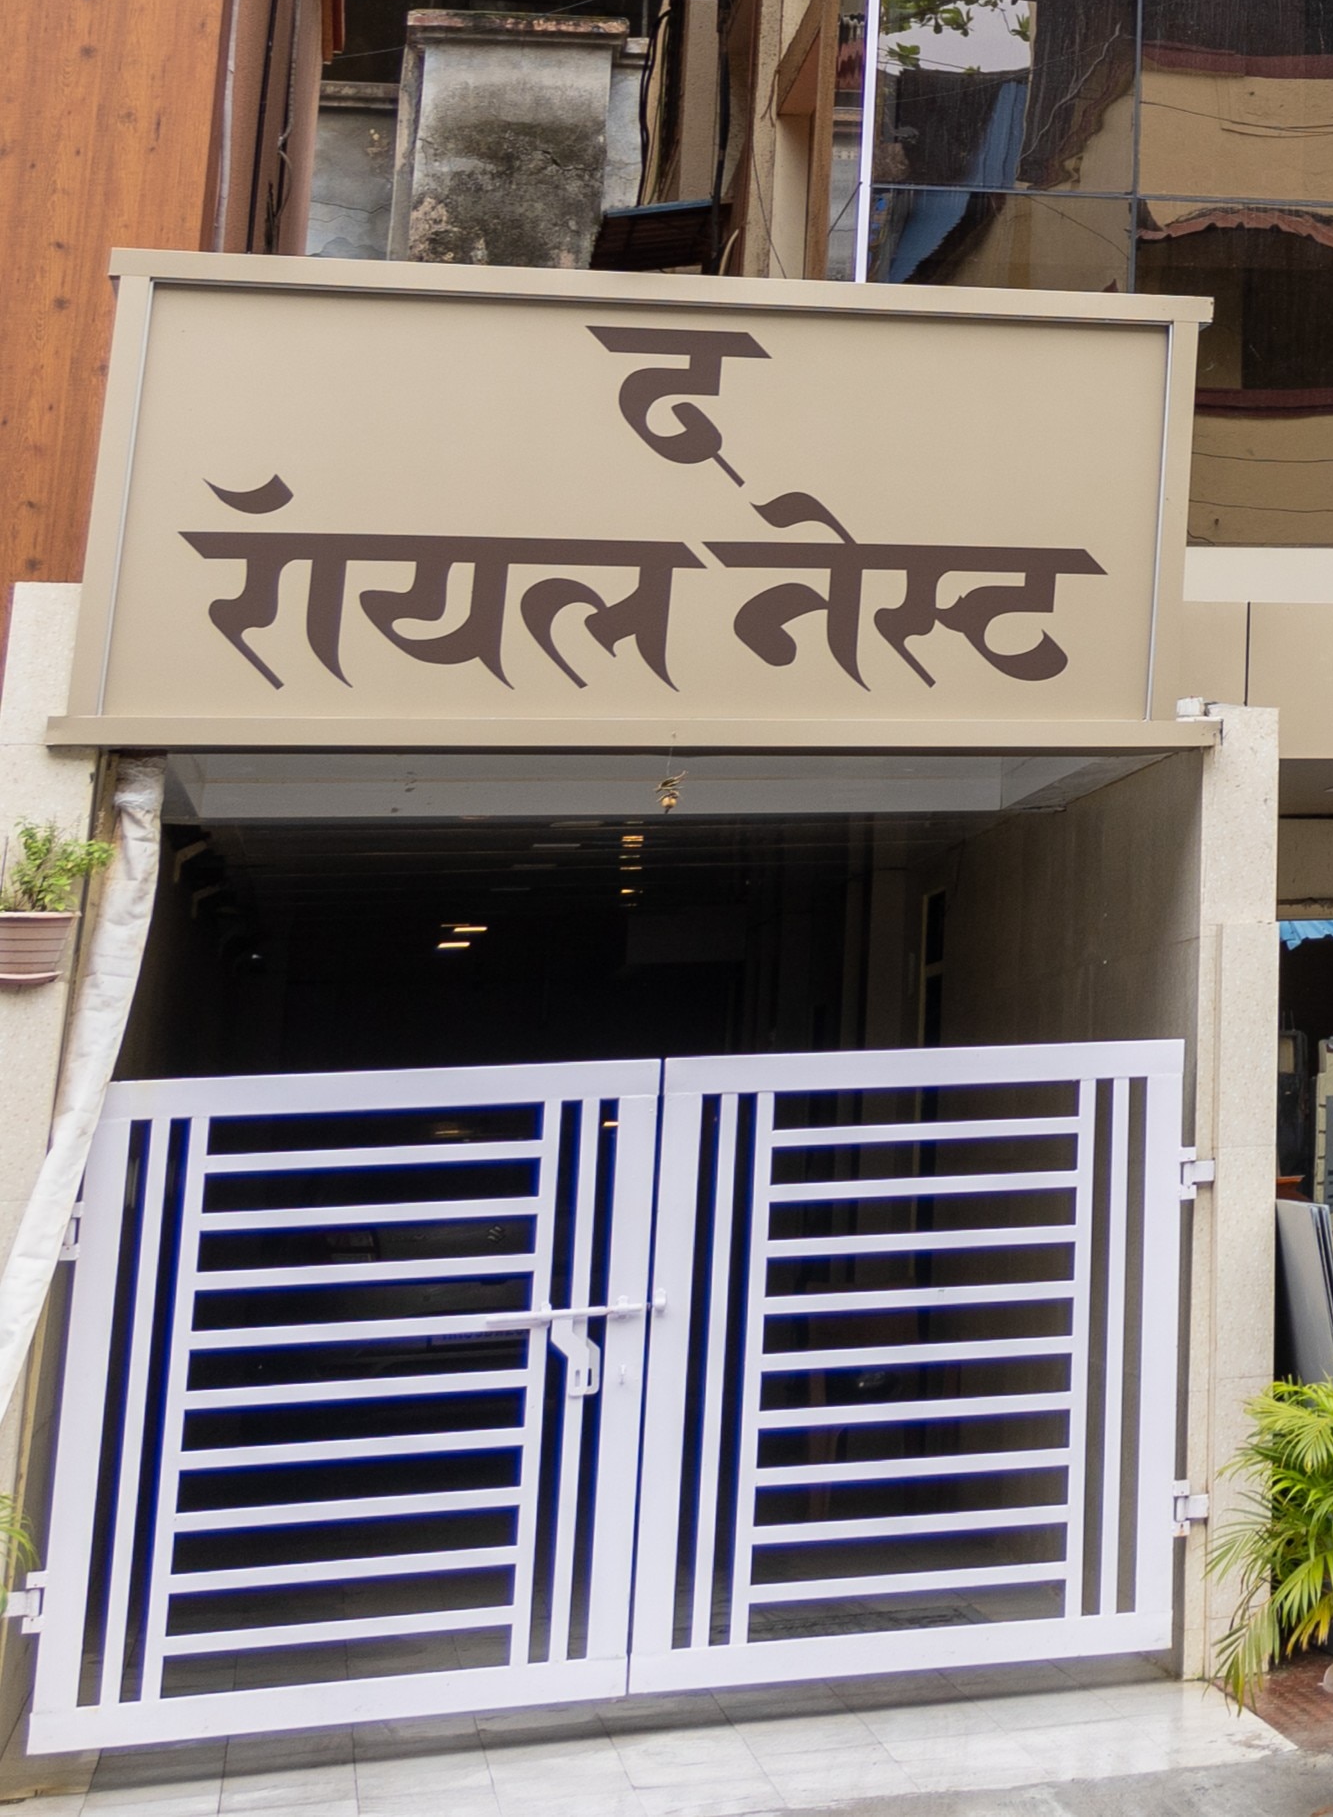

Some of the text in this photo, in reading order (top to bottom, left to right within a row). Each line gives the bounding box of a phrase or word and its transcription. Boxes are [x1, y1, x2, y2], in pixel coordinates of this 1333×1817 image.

[586, 325, 772, 488] द
[178, 473, 1108, 692] रॉयल नेस्ट
